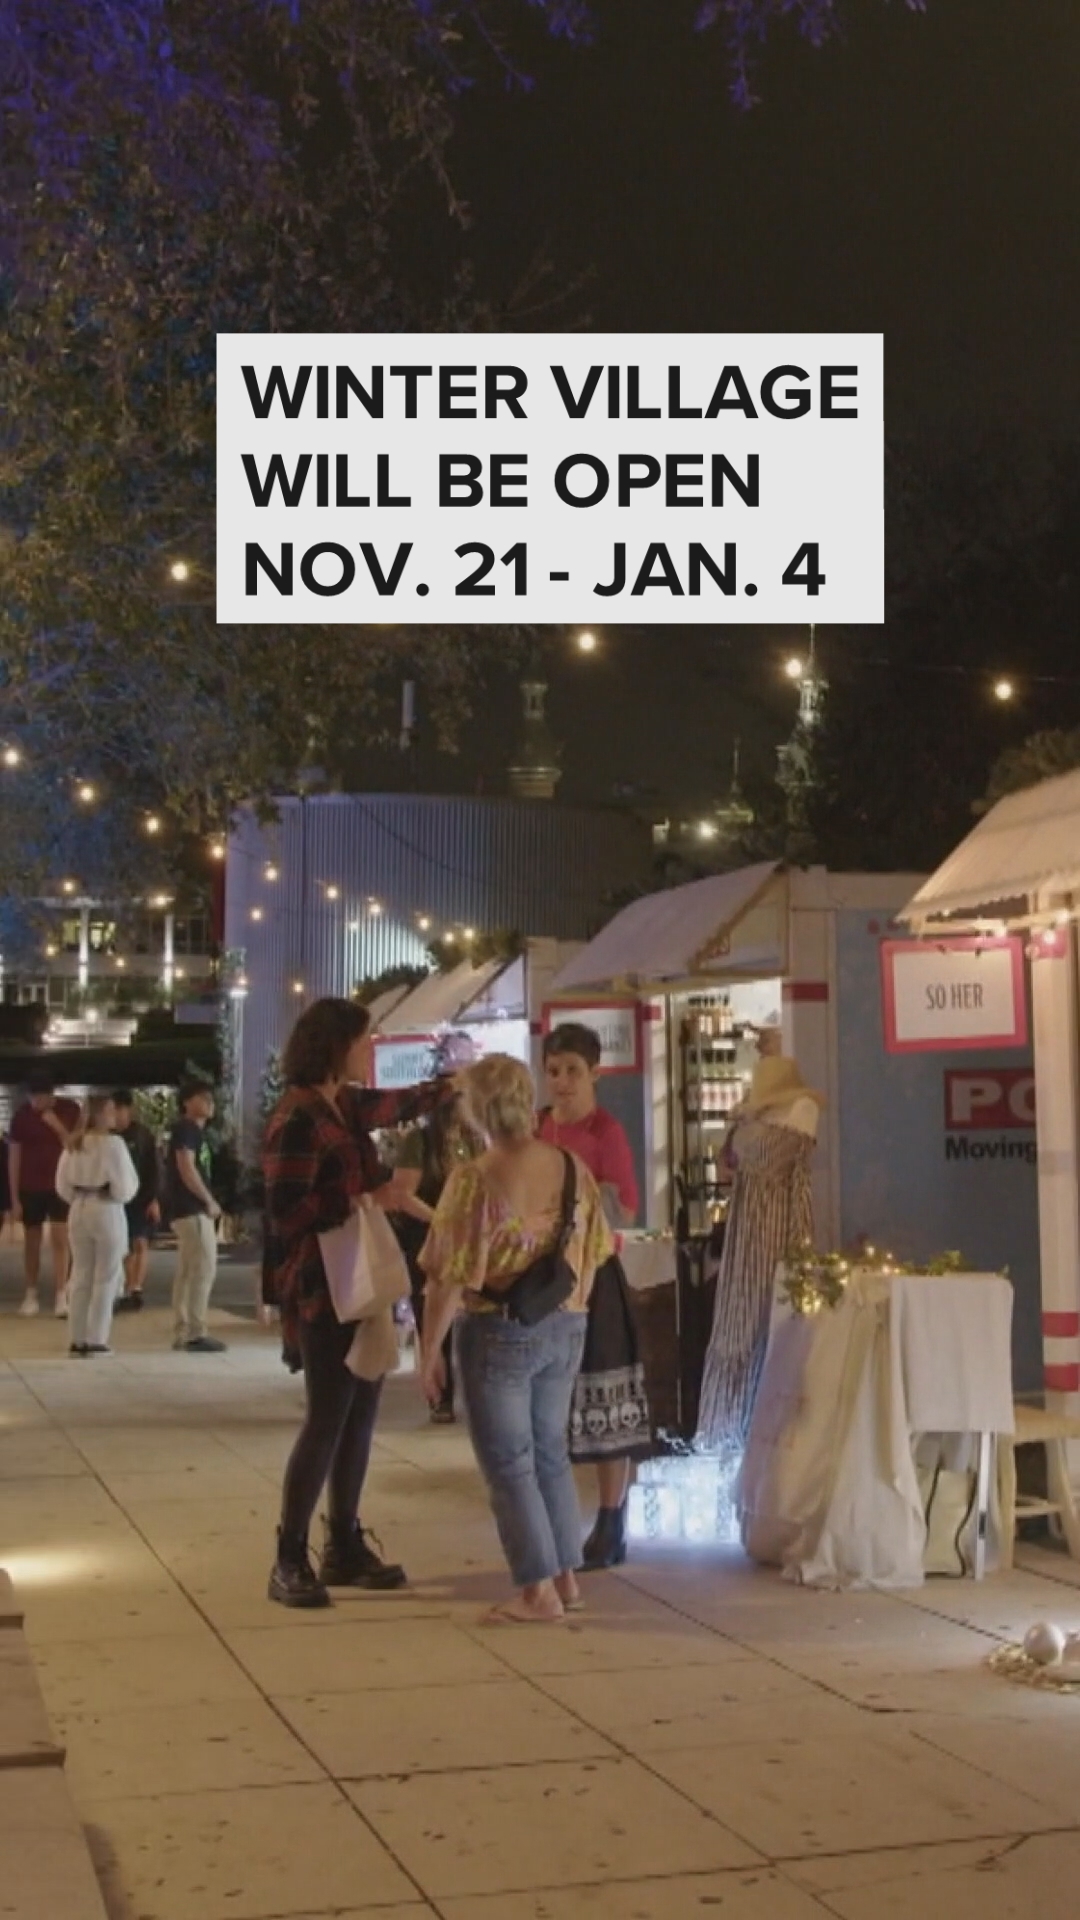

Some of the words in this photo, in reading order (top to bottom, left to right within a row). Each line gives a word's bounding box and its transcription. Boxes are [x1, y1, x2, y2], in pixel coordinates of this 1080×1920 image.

[925, 983, 947, 1010] SO
[950, 982, 983, 1010] HER
[945, 1135, 1037, 1165] Moving
